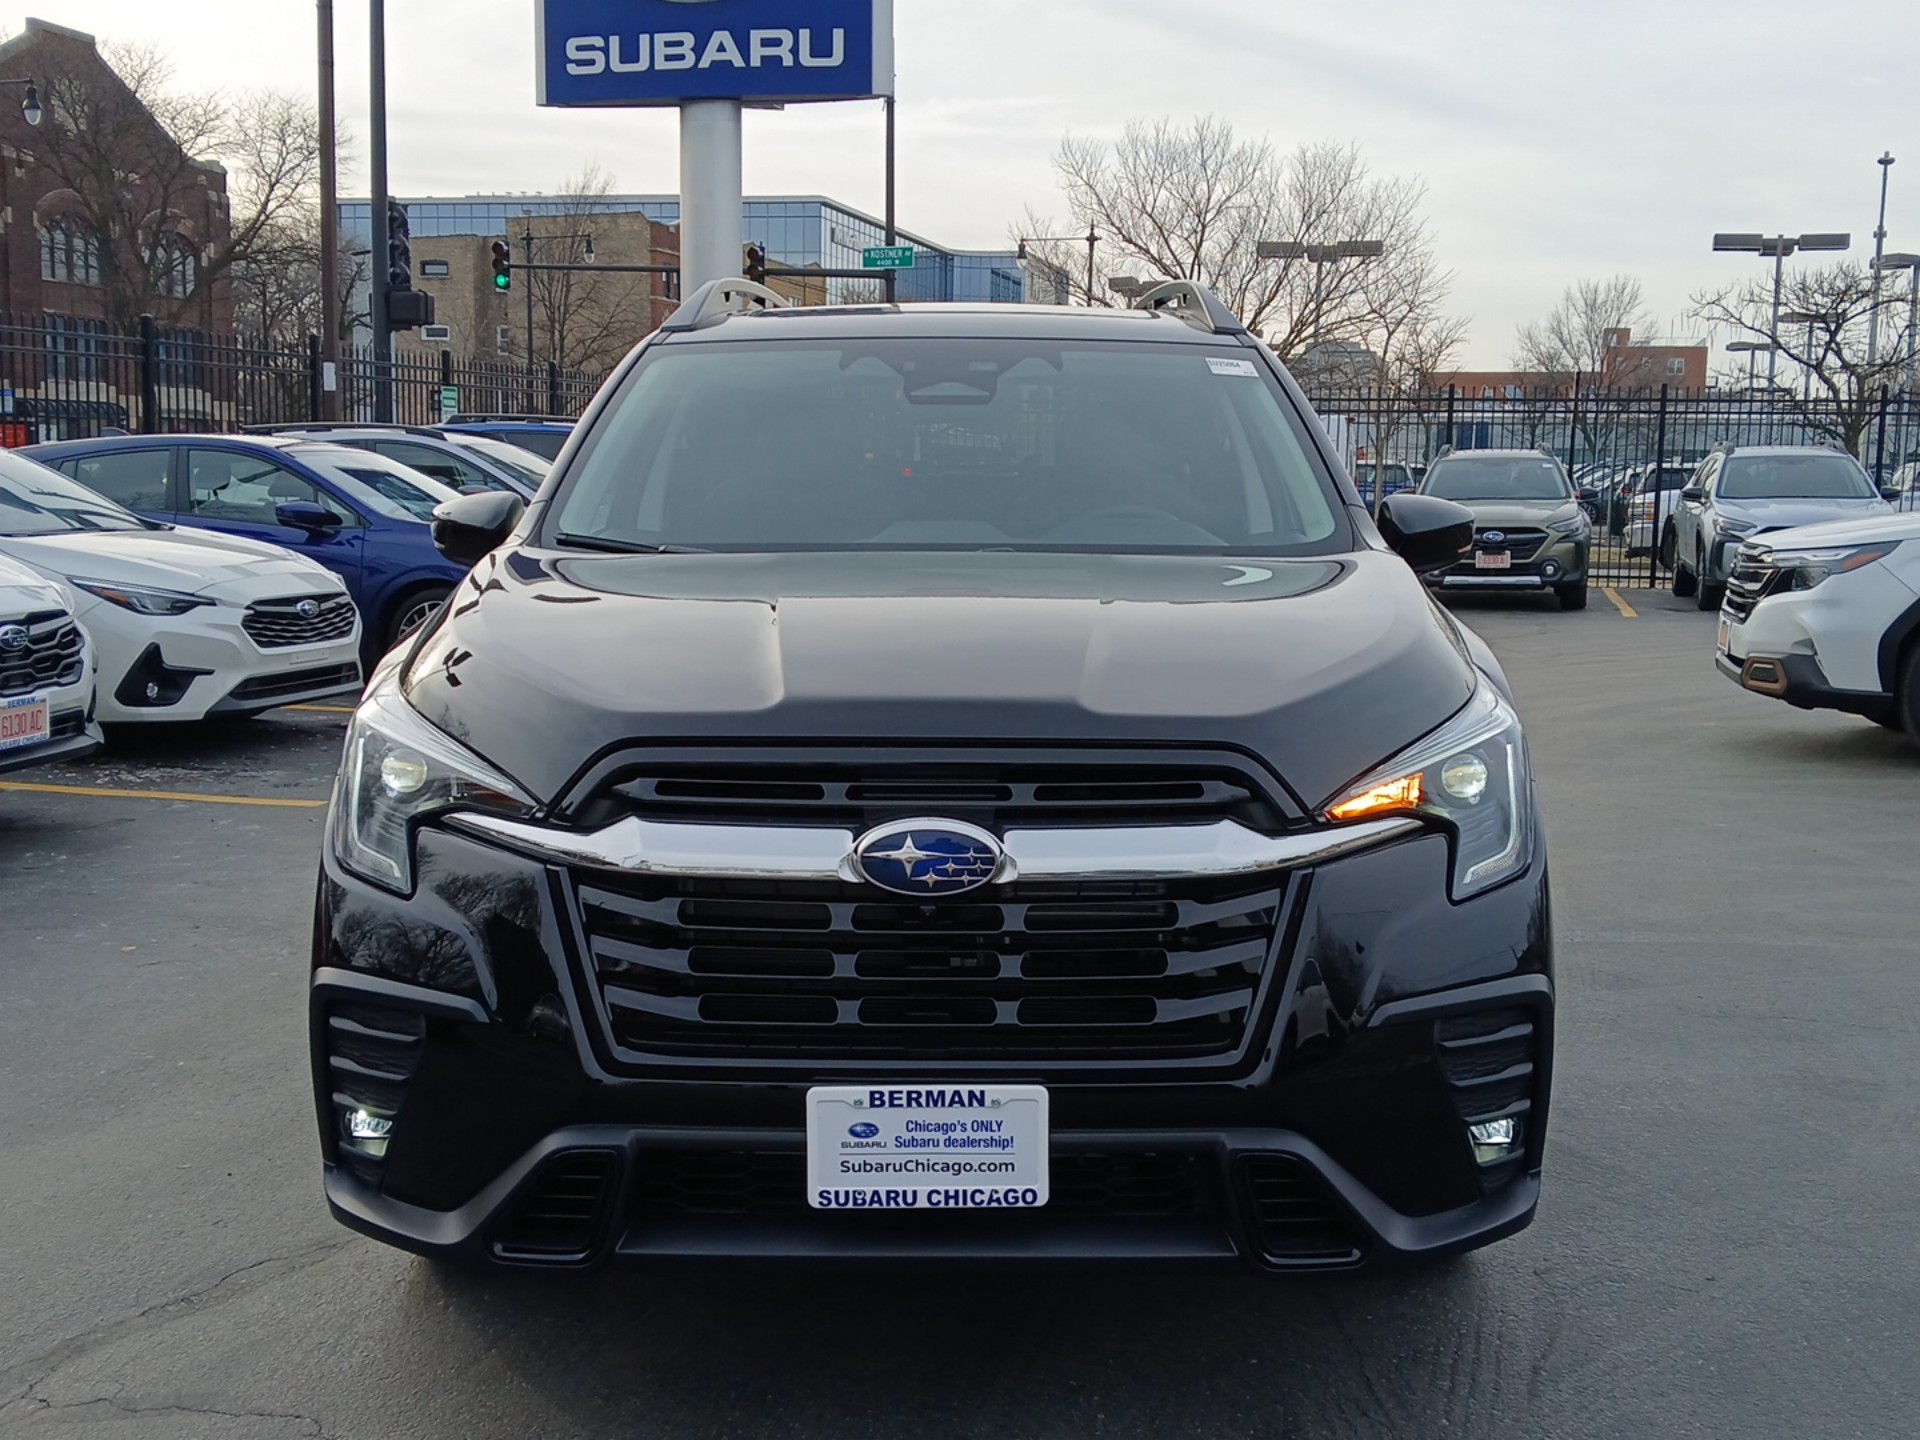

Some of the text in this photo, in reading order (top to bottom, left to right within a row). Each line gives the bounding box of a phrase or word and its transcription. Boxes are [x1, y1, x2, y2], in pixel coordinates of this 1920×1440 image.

[565, 28, 845, 76] SUBARU
[870, 249, 903, 258] KOSTNER
[2, 709, 42, 738] 6130 AC
[868, 1089, 986, 1109] BERMAN
[905, 1119, 1004, 1134] Chicago's ONLY
[840, 1141, 888, 1149] SUBARU
[894, 1135, 1014, 1151] Subaru dealership!
[839, 1158, 1016, 1176] SubaruChicago.com
[817, 1188, 1039, 1208] SUBARU CHICAGO
